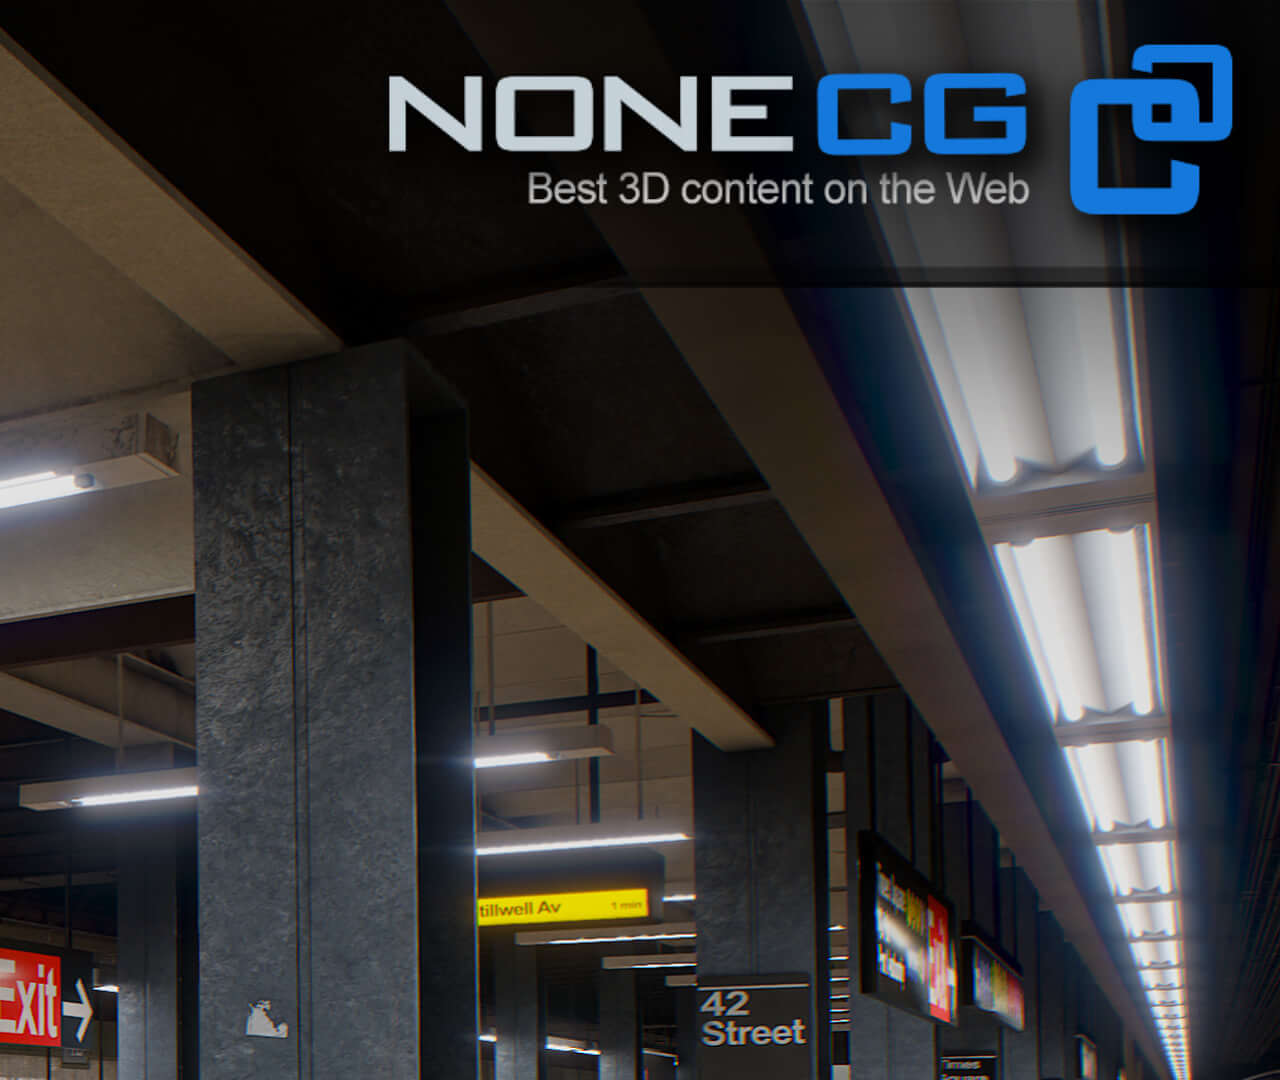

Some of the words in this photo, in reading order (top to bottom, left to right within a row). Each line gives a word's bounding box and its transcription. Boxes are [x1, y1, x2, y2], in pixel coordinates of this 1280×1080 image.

[537, 900, 562, 914] Av
[700, 990, 750, 1017] 42
[701, 1018, 807, 1047] Street
